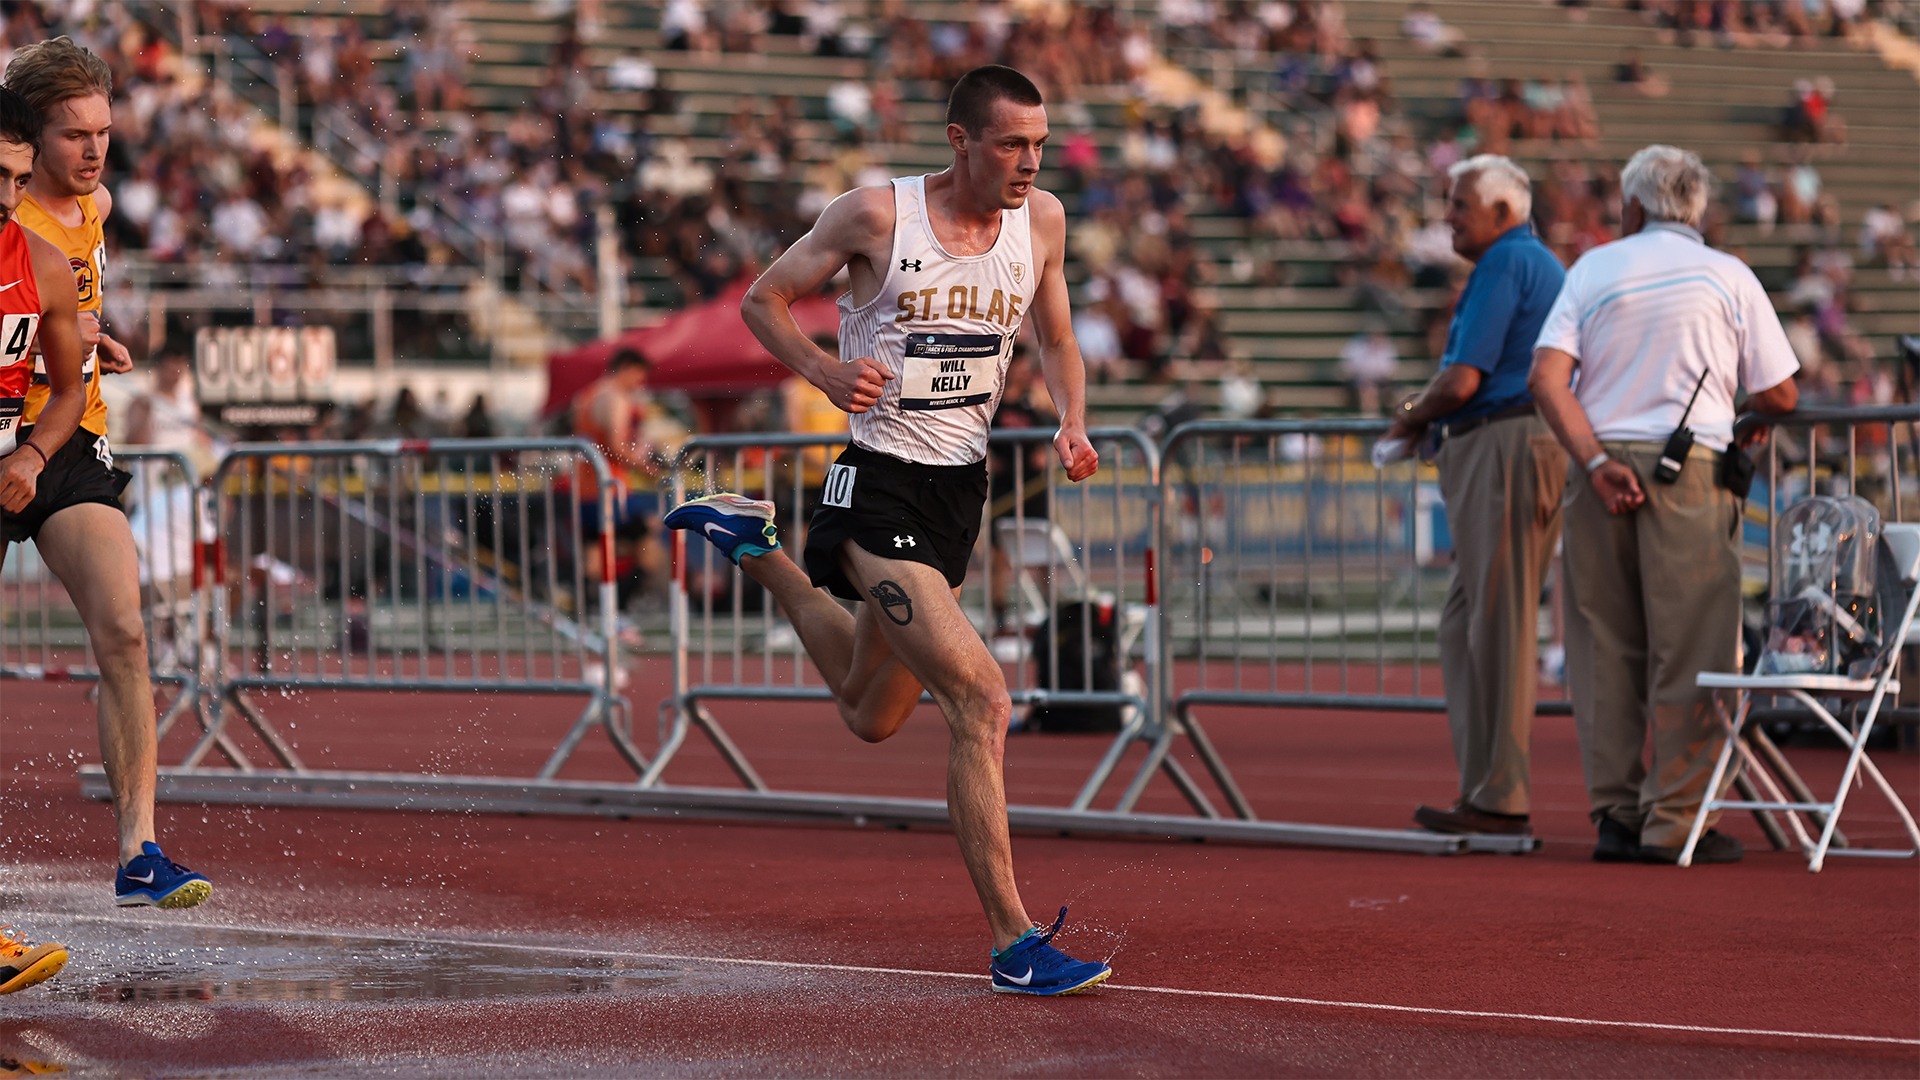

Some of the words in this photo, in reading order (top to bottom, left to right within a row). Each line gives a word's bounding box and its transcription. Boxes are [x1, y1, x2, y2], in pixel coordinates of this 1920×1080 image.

[895, 287, 940, 323] ST.
[946, 285, 1023, 328] OLAF
[924, 345, 940, 353] TRACK
[957, 345, 995, 353] CHAMPIONSHIPS
[940, 359, 966, 373] WILL
[930, 375, 972, 393] KELLY
[827, 465, 850, 505] 10
